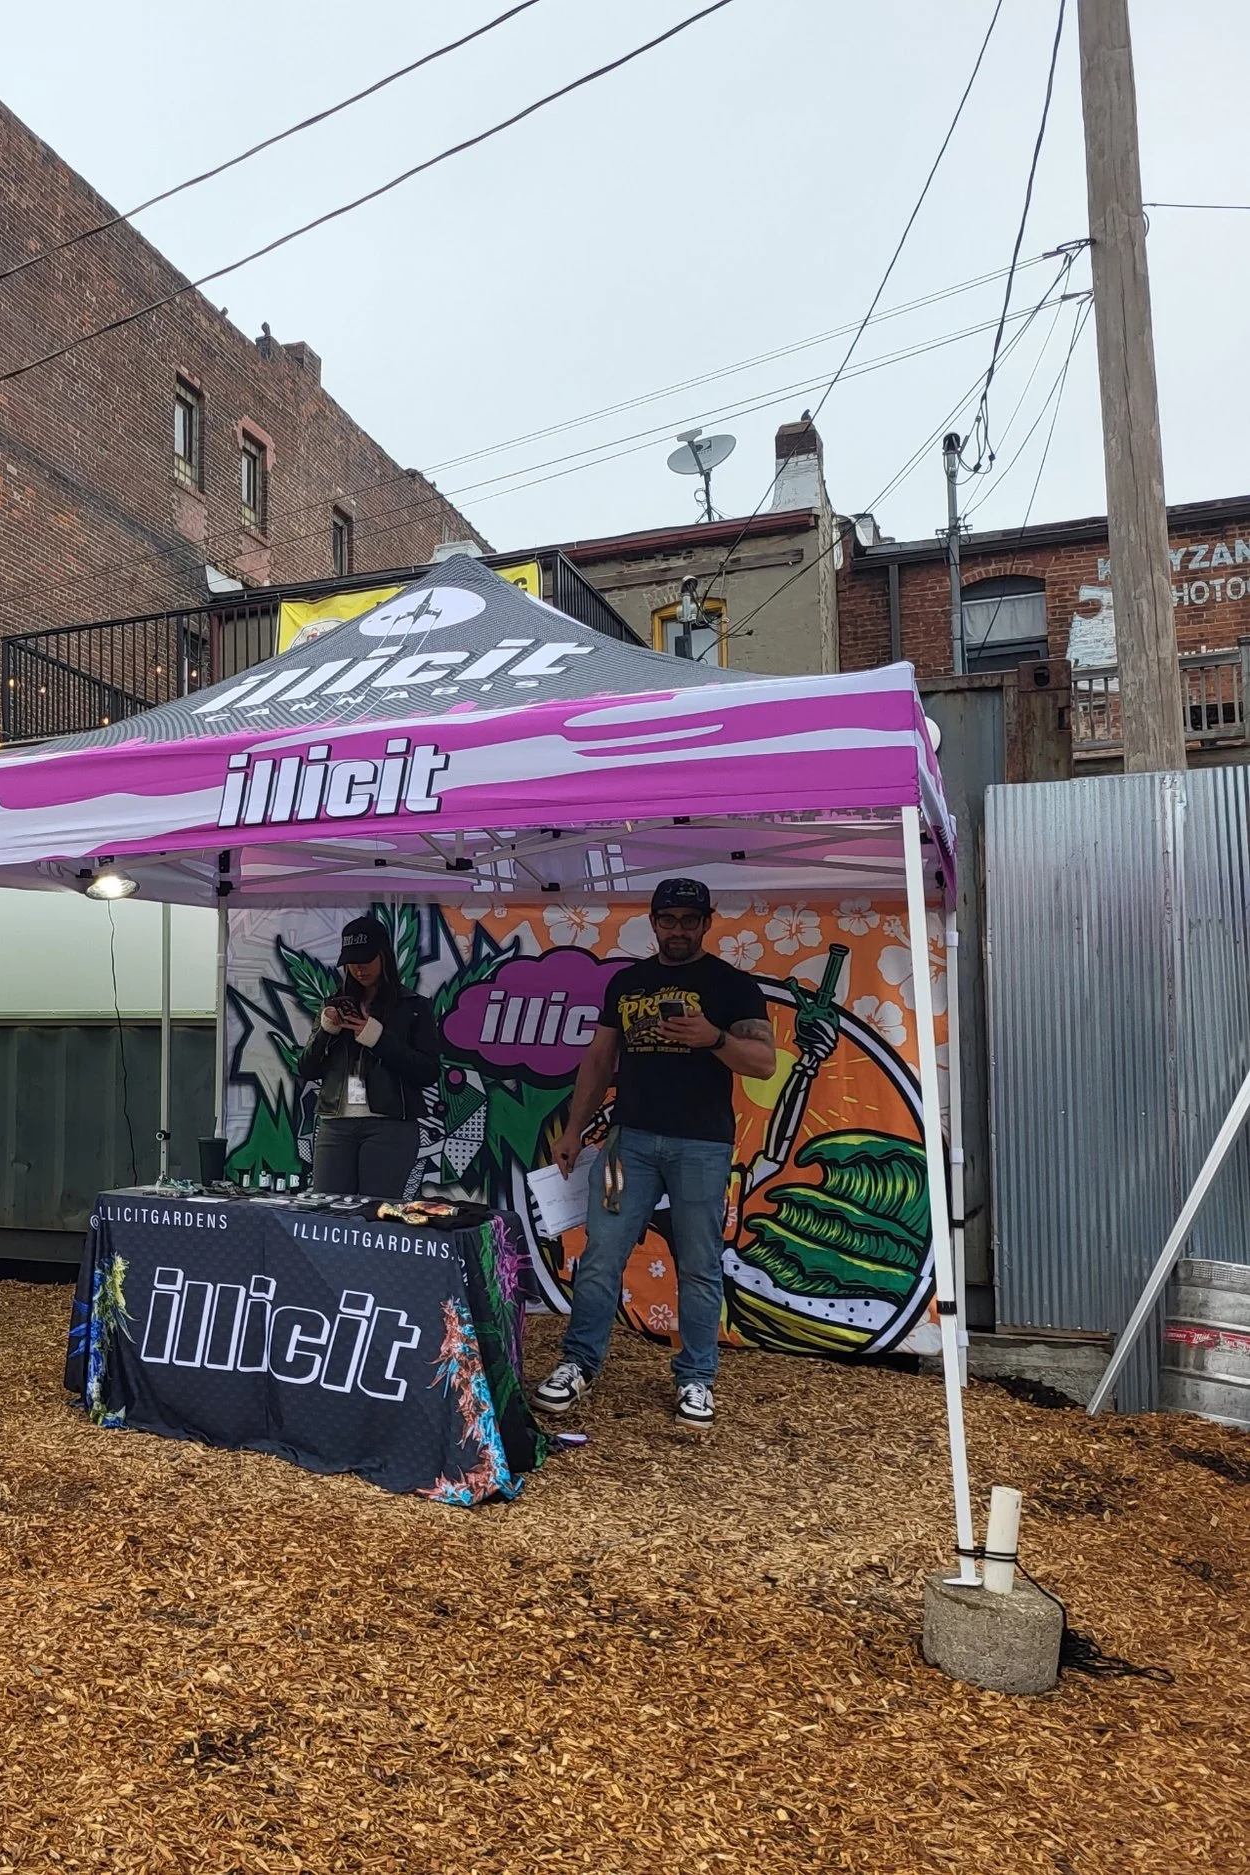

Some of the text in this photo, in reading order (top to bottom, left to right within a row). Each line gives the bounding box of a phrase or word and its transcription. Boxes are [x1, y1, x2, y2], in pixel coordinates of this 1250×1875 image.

[191, 639, 595, 715] illicit
[204, 680, 540, 723] CANNABIS
[217, 737, 449, 828] illicit
[479, 990, 600, 1046] illic
[90, 1205, 228, 1231] @LLICITGARDENS
[141, 1266, 421, 1402] illicit
